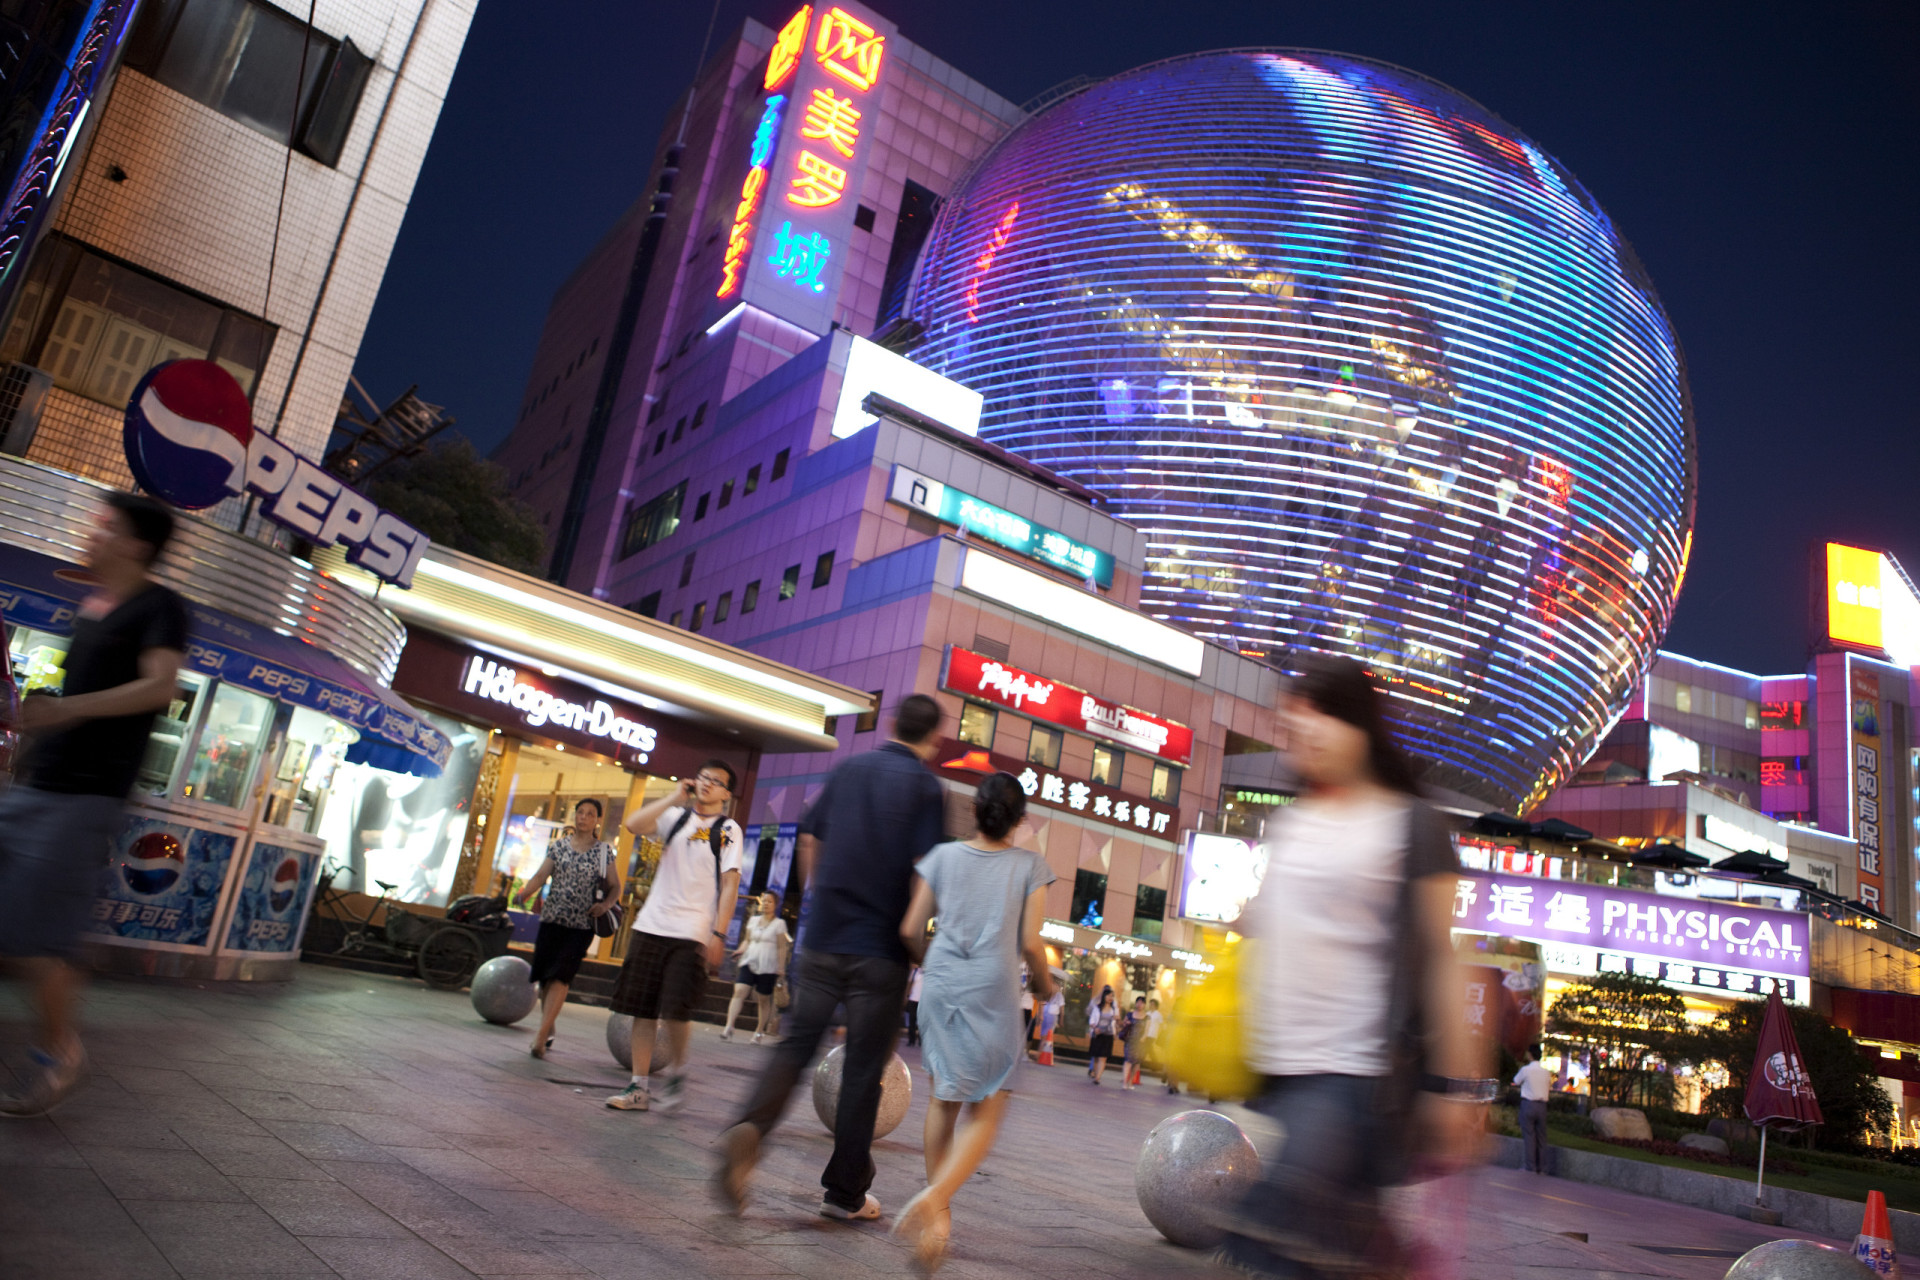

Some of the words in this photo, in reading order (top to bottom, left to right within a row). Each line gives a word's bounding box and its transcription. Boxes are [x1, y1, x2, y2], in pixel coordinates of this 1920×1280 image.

[767, 87, 863, 293] 美罗城
[225, 429, 430, 588] PEPSI
[184, 643, 228, 670] PSI
[248, 664, 311, 696] PEPSI
[317, 688, 365, 716] PEPSI
[1236, 790, 1297, 807] STARBUC
[1856, 744, 1880, 876] 网购有保证
[94, 897, 183, 930] 百事可乐
[1602, 899, 1803, 951] PHYSICAL
[1602, 925, 1686, 947] FITNESS
[1725, 943, 1802, 962] BEAUTY
